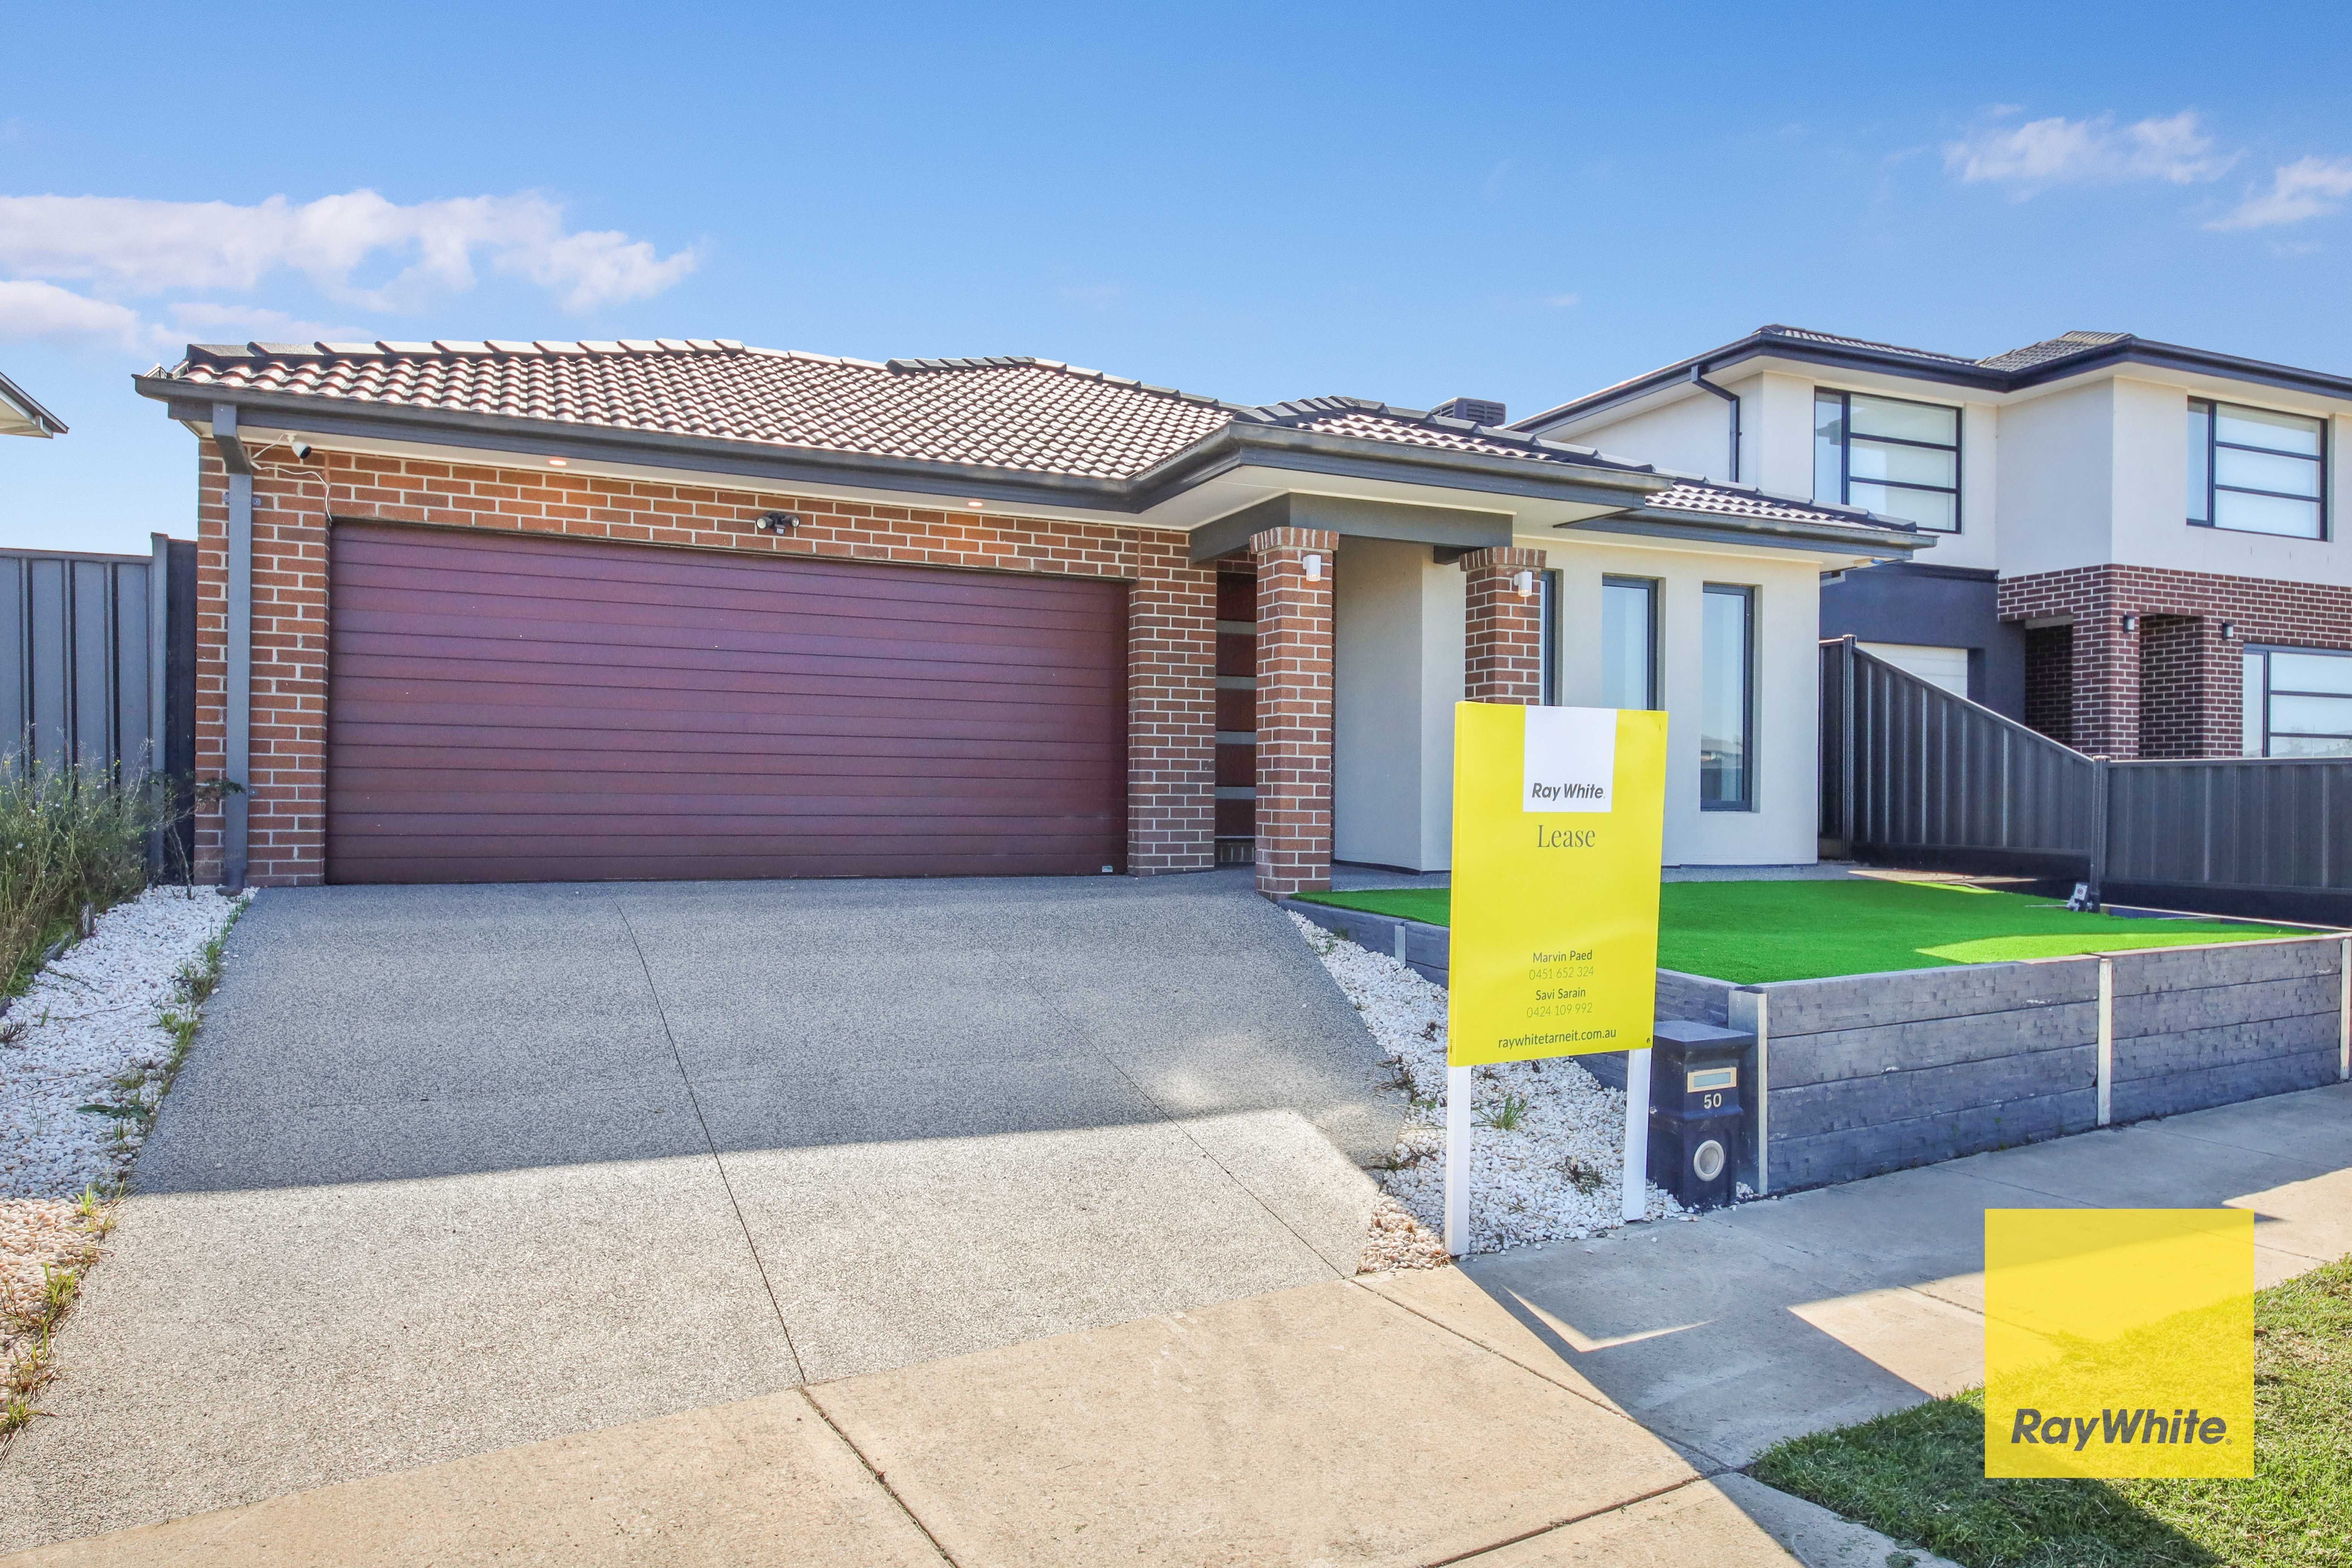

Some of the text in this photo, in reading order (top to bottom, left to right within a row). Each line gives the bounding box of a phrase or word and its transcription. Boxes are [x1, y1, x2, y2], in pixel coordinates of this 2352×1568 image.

[1532, 782, 1603, 801] Ray White
[1537, 825, 1596, 848] Lease
[1533, 949, 1592, 963] Marvin Paed
[1529, 965, 1594, 980] 0451 652 324
[1536, 987, 1586, 1001] Savi Sarain
[1527, 1002, 1592, 1018] 0424 109 992
[1498, 1029, 1616, 1050] raywhitetarneit.com.au
[1704, 1093, 1722, 1109] 50
